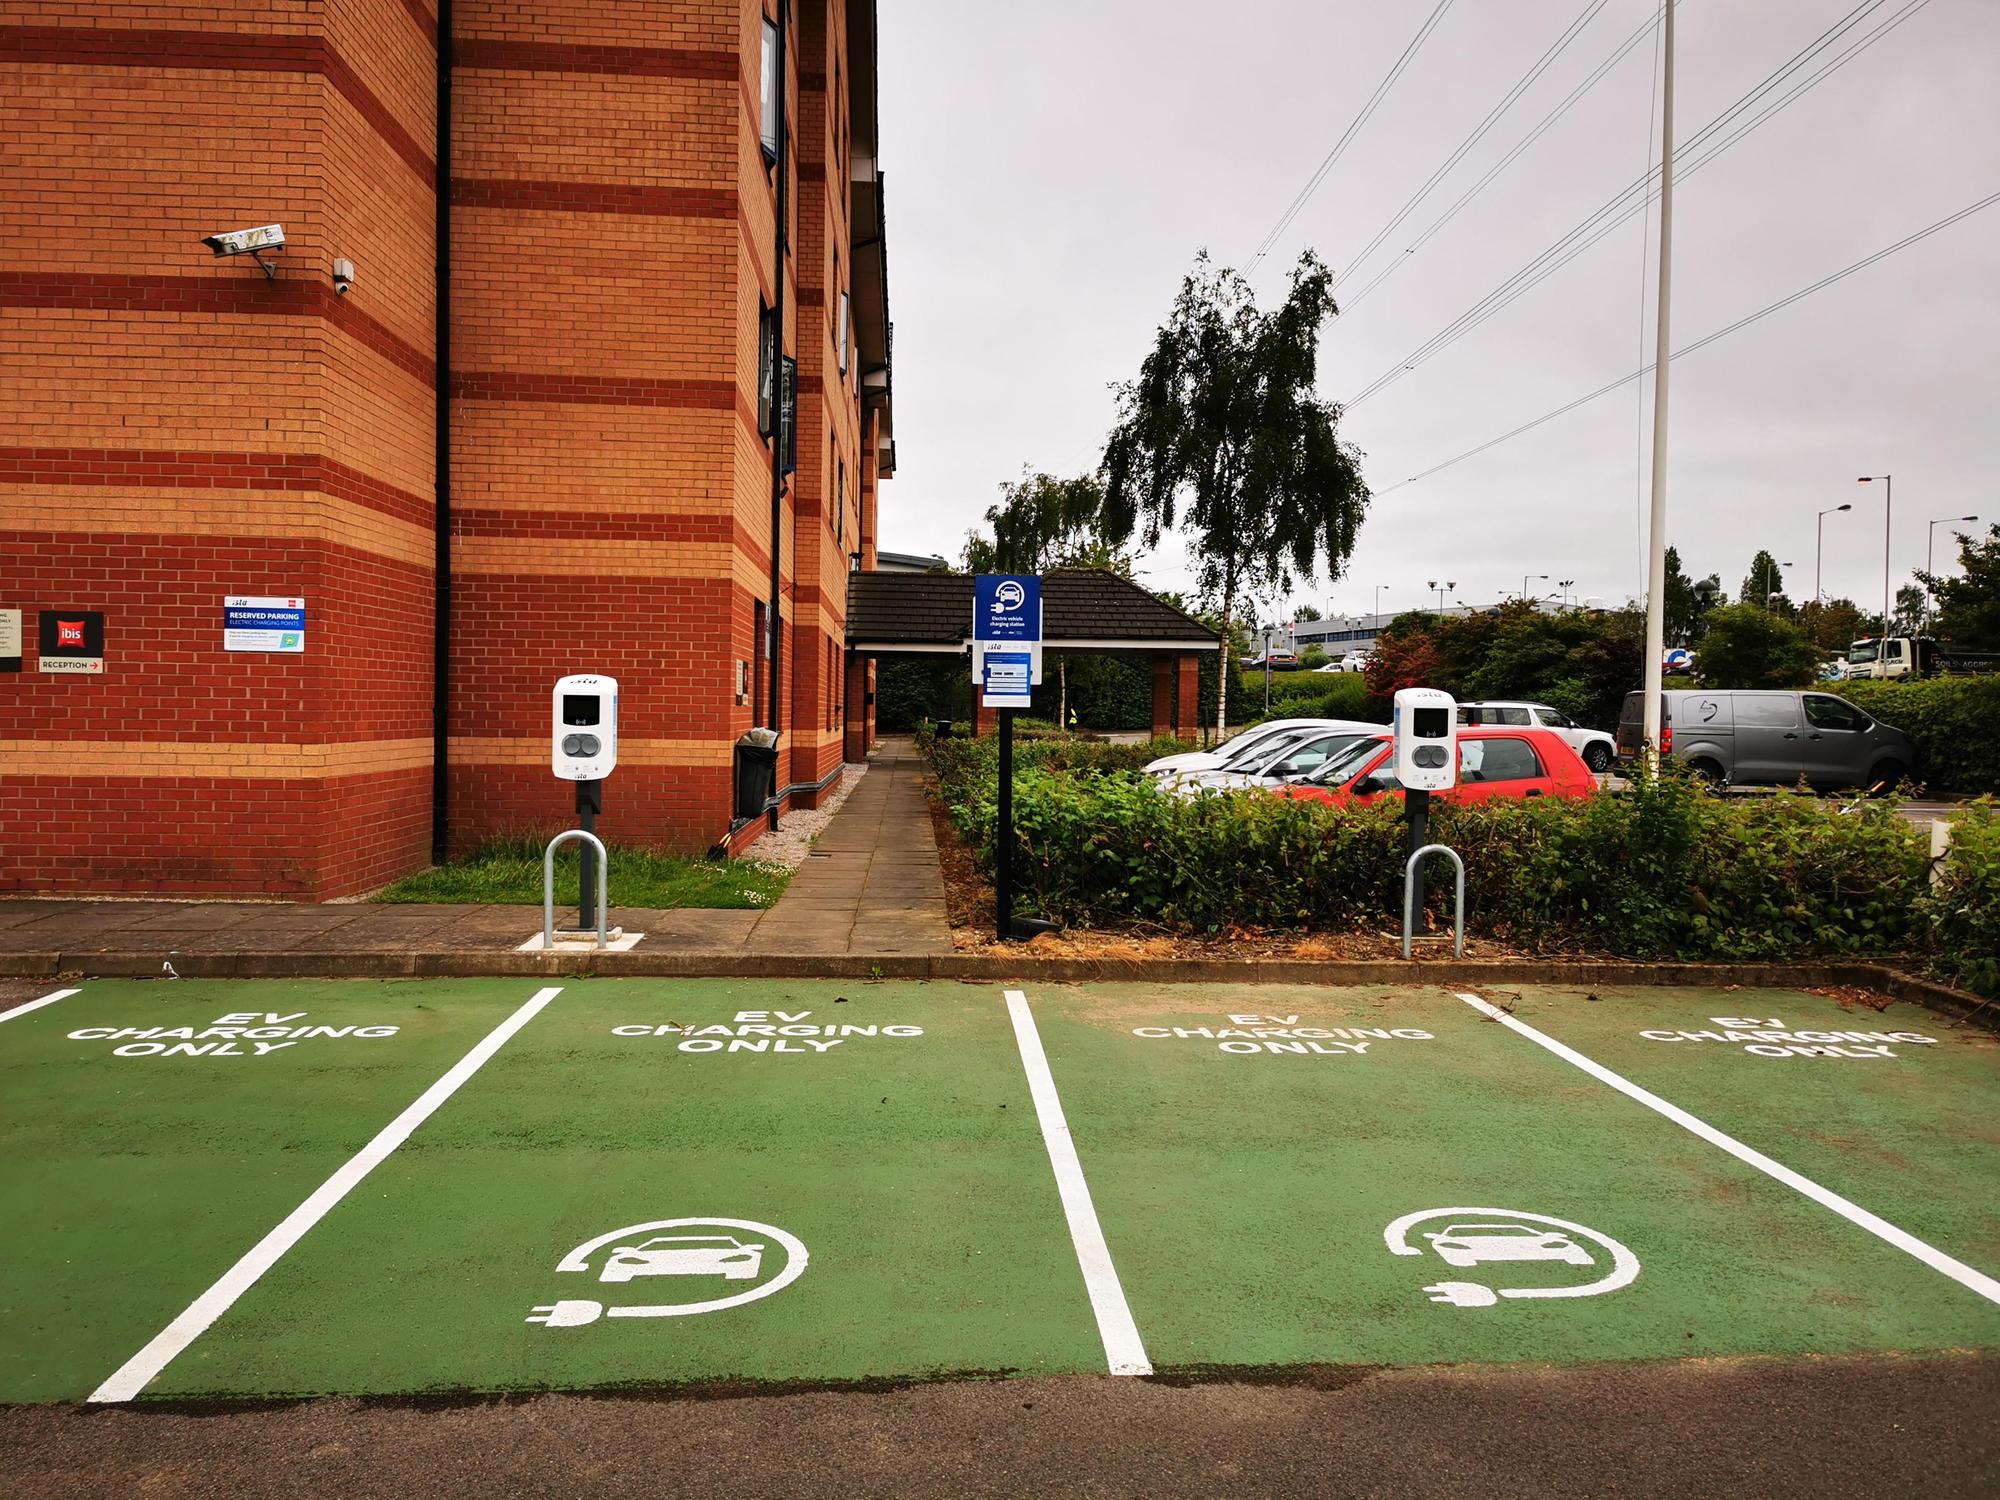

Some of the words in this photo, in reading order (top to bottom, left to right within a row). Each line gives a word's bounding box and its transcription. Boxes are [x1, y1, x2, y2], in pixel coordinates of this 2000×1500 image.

[61, 628, 81, 639] ibis
[42, 661, 88, 669] RECEPTION
[211, 1012, 308, 1025] EV
[733, 1010, 812, 1022] EV
[1227, 1014, 1299, 1025] EV
[1709, 1017, 1786, 1028] EV
[66, 1025, 401, 1039] CHARGING
[611, 1024, 925, 1036] CHARGING
[1132, 1027, 1436, 1039] CHARGING
[1639, 1030, 1938, 1044] CHARGING
[112, 1041, 299, 1057] ONLY
[677, 1039, 844, 1052] ONLY
[1218, 1041, 1371, 1054] ONLY
[1744, 1044, 1898, 1058] ONLY
